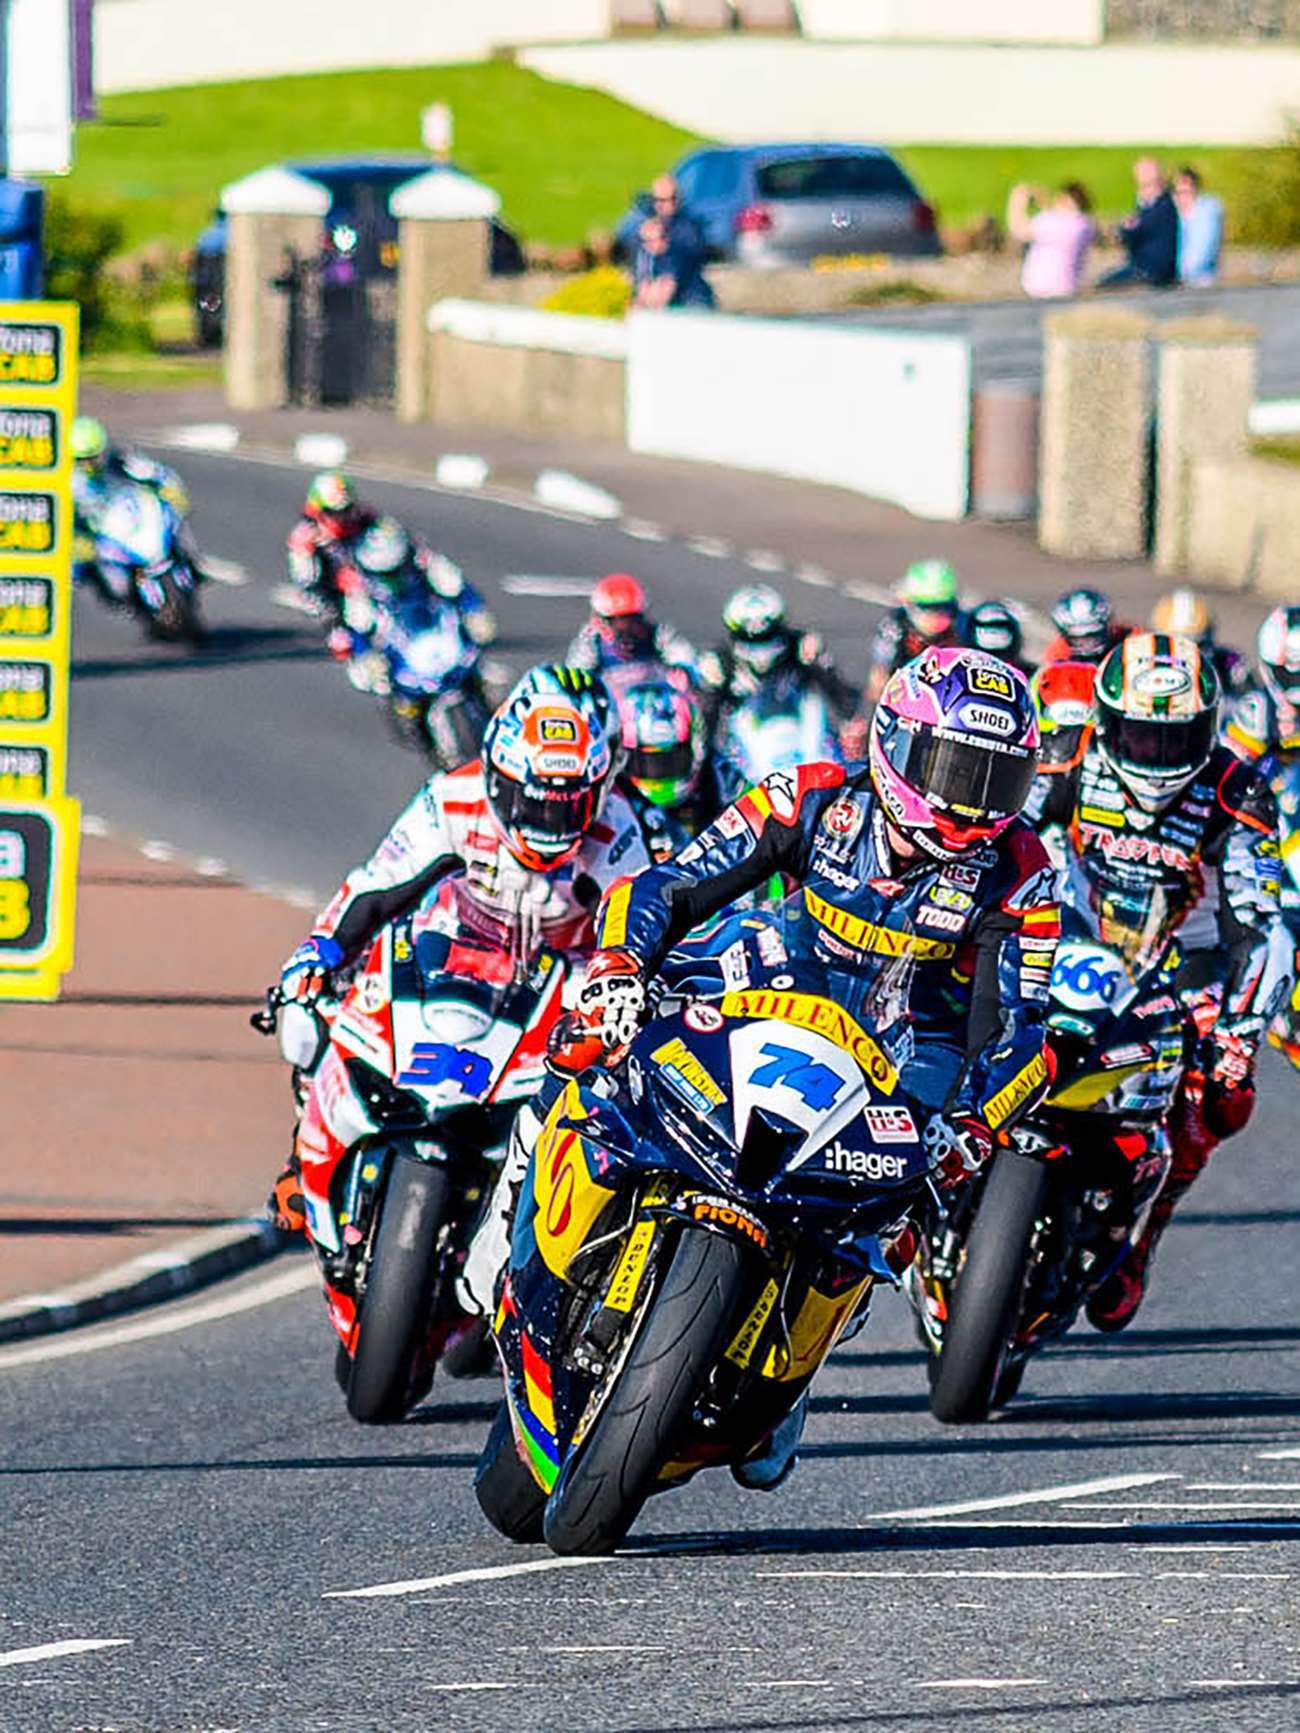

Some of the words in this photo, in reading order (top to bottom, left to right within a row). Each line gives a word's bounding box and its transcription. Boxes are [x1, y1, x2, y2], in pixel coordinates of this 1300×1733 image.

[975, 676, 1009, 695] CAB
[969, 709, 1010, 731] SHOEI
[915, 905, 966, 933] TODD
[735, 996, 888, 1082] MILENCO
[747, 1042, 847, 1113] 74
[694, 1204, 767, 1249] FIONA
